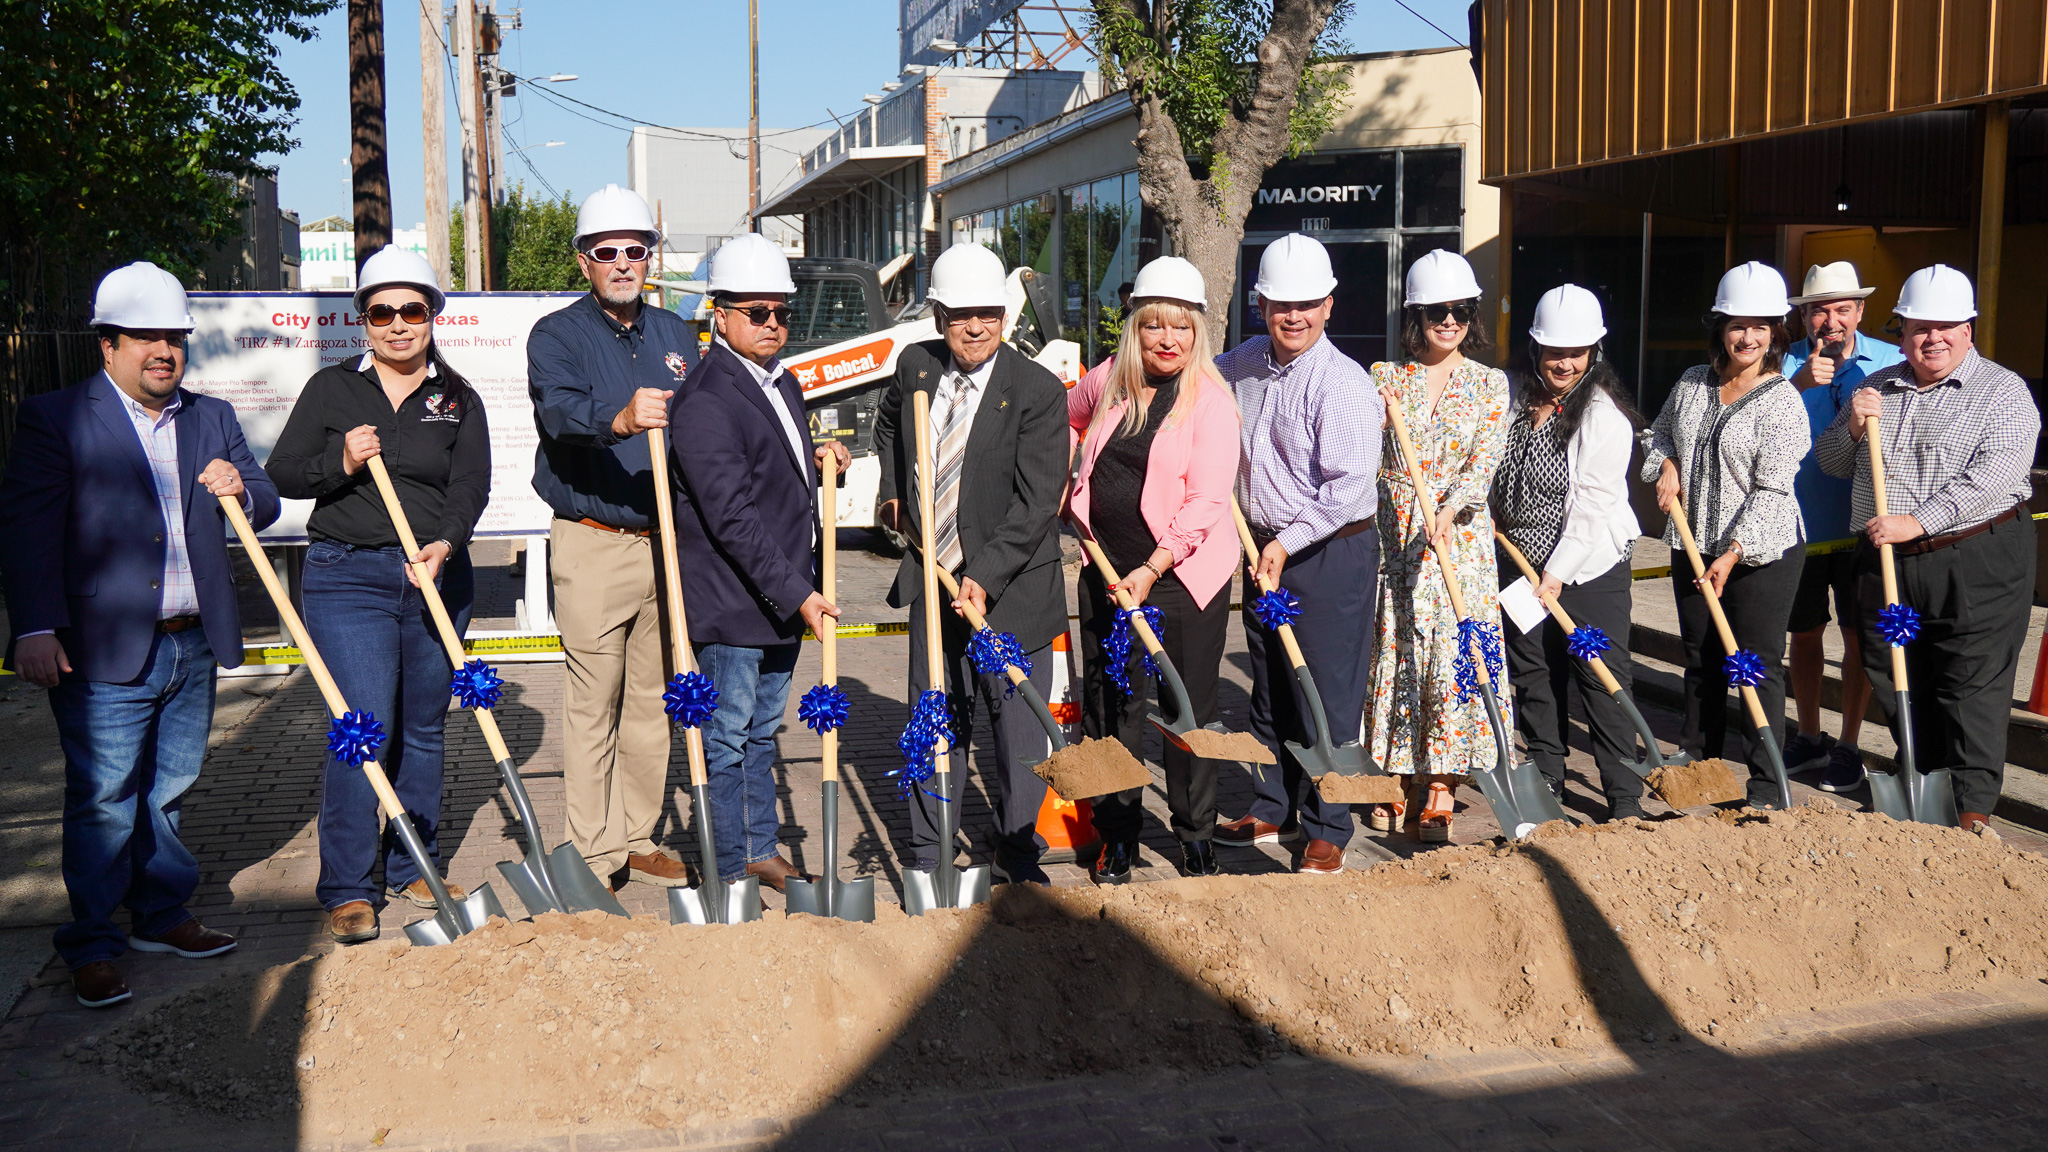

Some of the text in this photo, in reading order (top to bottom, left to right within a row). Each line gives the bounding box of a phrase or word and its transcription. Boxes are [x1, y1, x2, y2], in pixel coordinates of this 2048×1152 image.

[1258, 184, 1383, 204] MAJORITY
[1303, 217, 1329, 230] 1110
[271, 312, 480, 329] City of La exas
[295, 336, 347, 352] Zaragoza
[435, 336, 470, 347] ments
[208, 380, 228, 389] Mayor
[241, 379, 268, 388] Tempore
